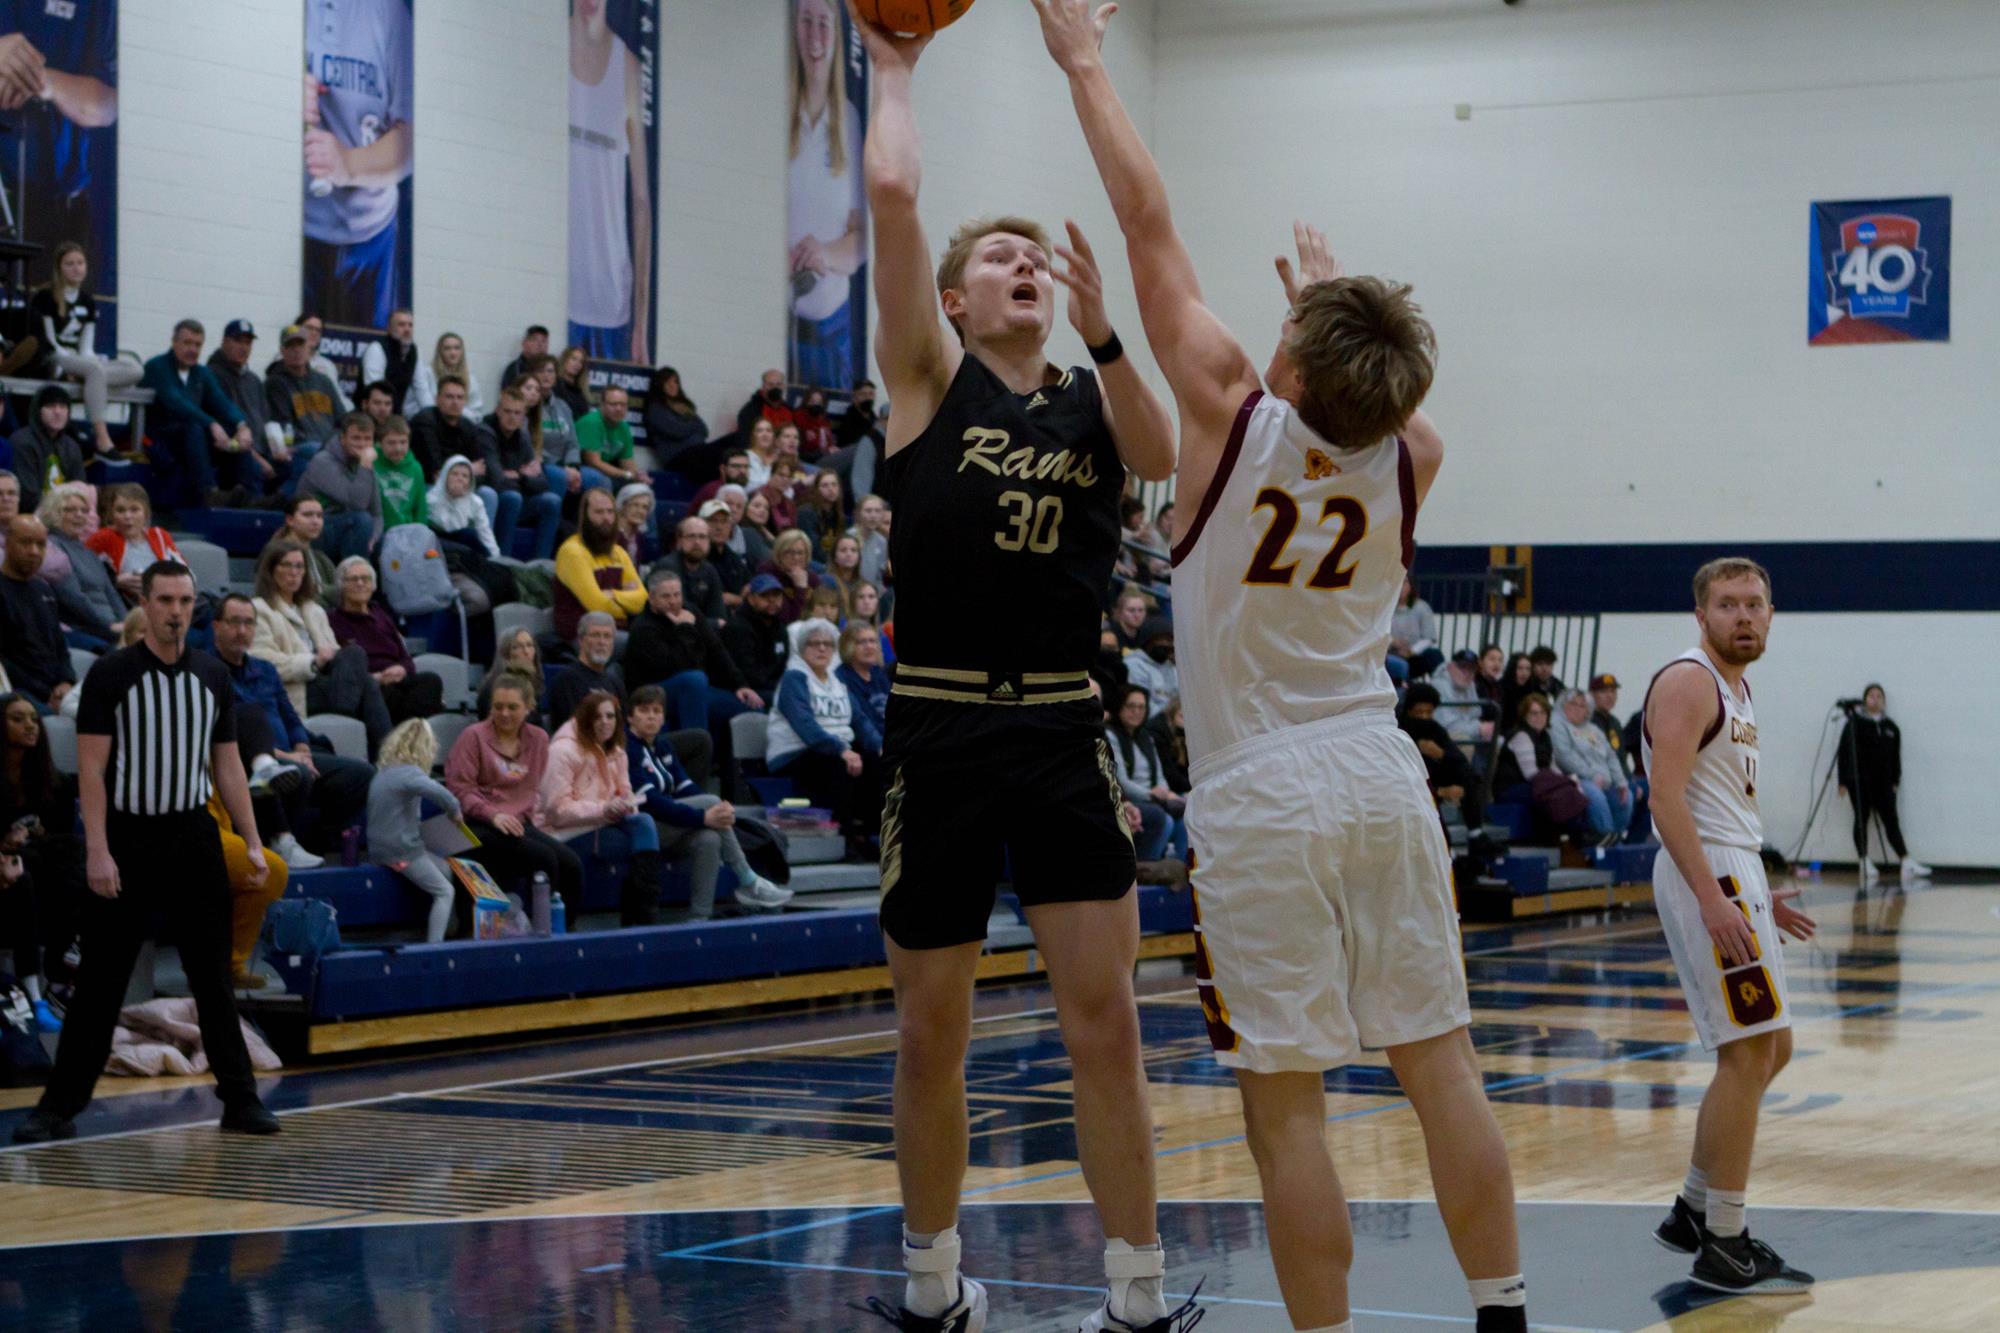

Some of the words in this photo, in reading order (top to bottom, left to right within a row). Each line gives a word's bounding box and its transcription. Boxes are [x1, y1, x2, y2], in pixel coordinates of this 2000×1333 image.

[322, 54, 383, 100] CENTRAL
[641, 46, 653, 127] FIELD
[1839, 244, 1916, 295] 40
[1861, 295, 1898, 306] YEARS
[957, 426, 1099, 487] Rams
[994, 490, 1064, 554] 30
[1241, 485, 1369, 591] 22
